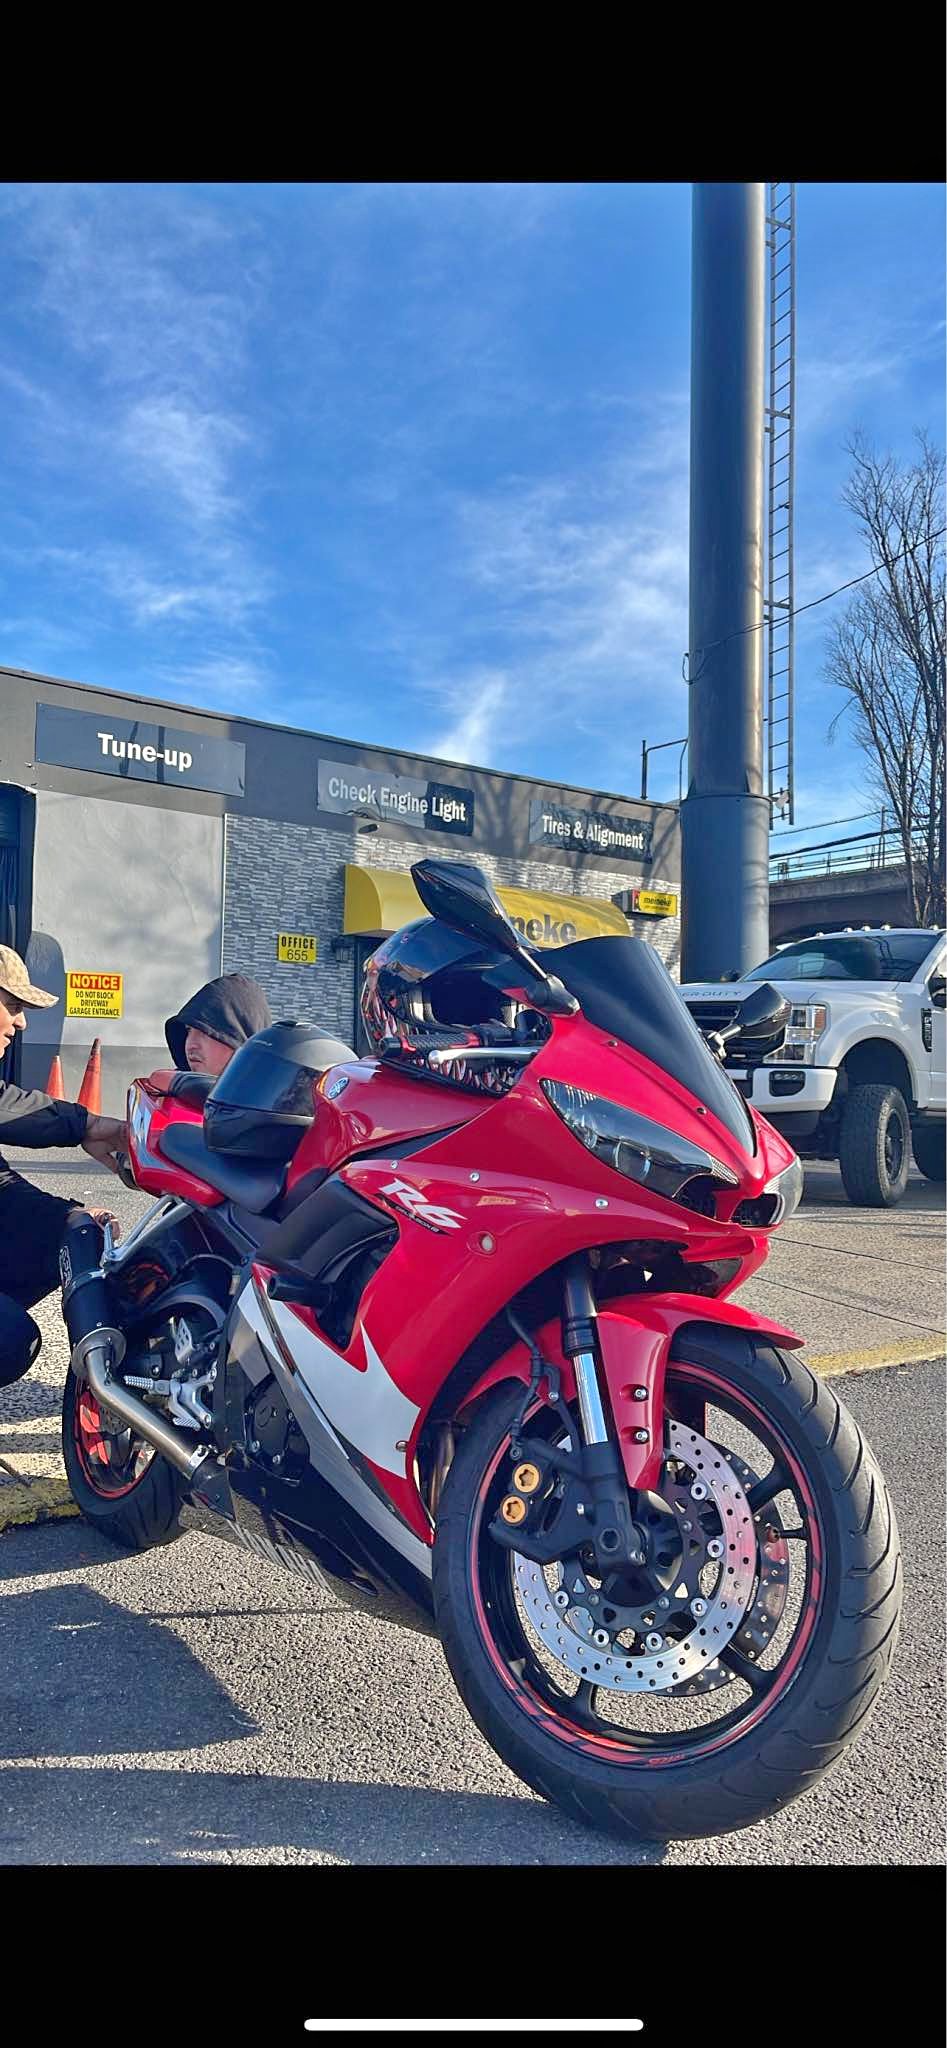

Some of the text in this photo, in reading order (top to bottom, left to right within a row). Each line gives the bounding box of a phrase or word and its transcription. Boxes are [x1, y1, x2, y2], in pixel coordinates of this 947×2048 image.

[97, 732, 192, 772] Tune-up
[328, 777, 466, 822] Check Engine Light
[542, 814, 644, 850] Tires & Alignment
[507, 914, 577, 943] neke
[281, 936, 315, 949] OFFICE
[287, 949, 308, 961] 655
[72, 975, 118, 989] NOTICE
[85, 991, 96, 999] NOT
[97, 991, 114, 1000] BLOCK
[80, 999, 109, 1007] DRIVEWAY
[70, 1007, 120, 1017] GARAGE ENTRANCE
[378, 1178, 468, 1229] R6
